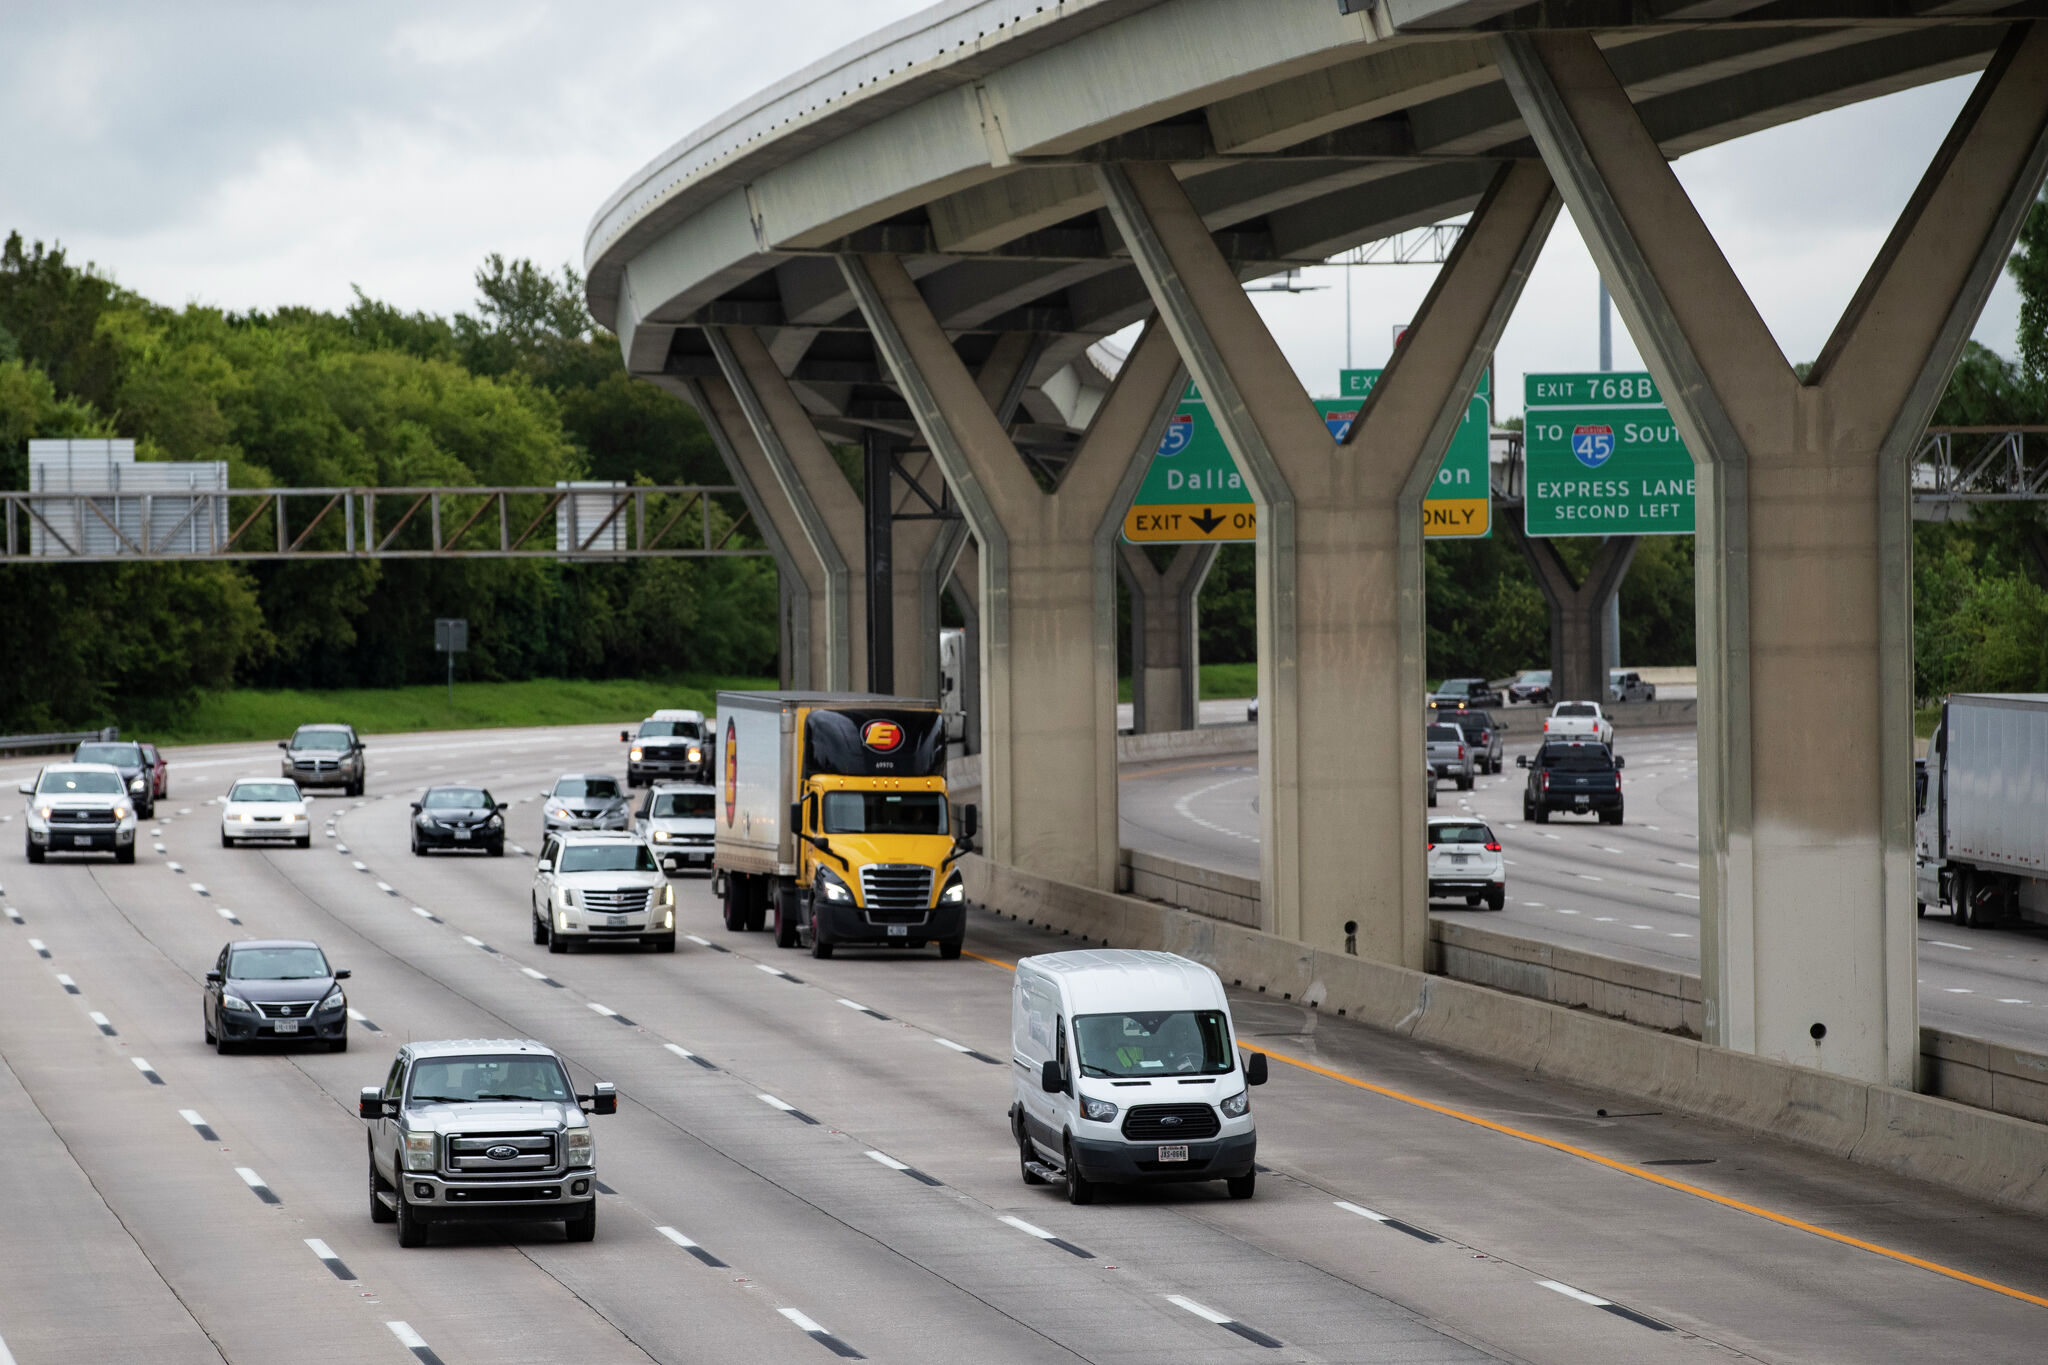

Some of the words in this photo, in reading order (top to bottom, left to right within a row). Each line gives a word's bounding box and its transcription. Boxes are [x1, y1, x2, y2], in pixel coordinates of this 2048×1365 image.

[1351, 376, 1378, 389] EX
[1537, 383, 1574, 397] EXIT
[1587, 378, 1652, 399] 768B
[1335, 422, 1350, 439] 4
[1535, 425, 1563, 441] TO
[1577, 436, 1610, 459] 45
[1624, 424, 1680, 443] SOUT
[1167, 469, 1241, 490] Dalla
[1537, 481, 1630, 498] EXPRESS
[1555, 504, 1629, 519] SECOND
[1639, 503, 1680, 518] LEFT
[1136, 514, 1182, 531] EXIT
[1233, 513, 1256, 529] ON
[866, 724, 898, 745] E
